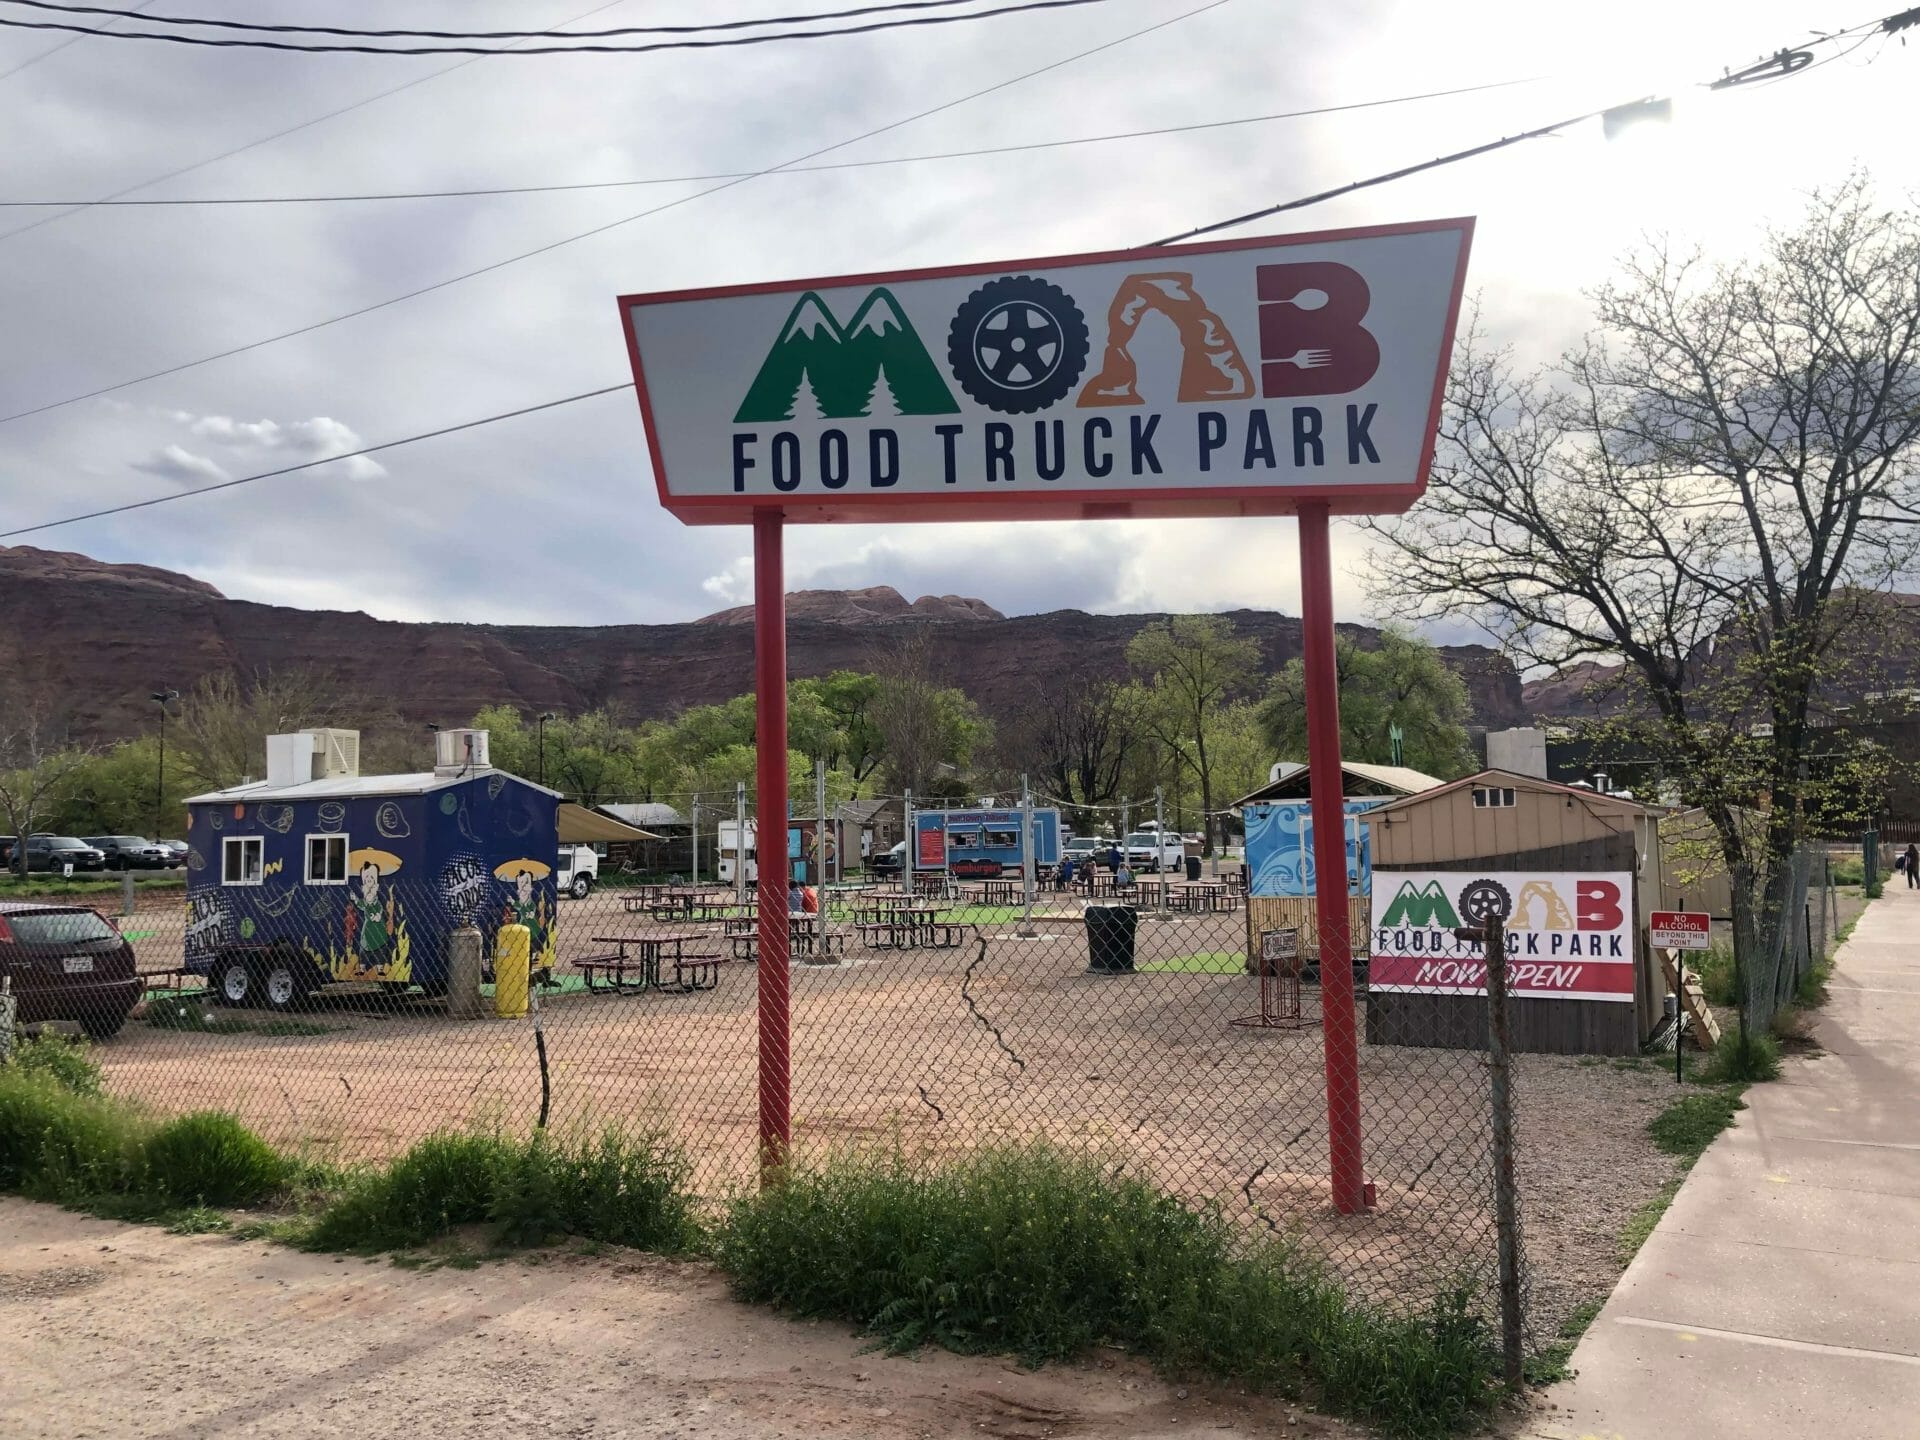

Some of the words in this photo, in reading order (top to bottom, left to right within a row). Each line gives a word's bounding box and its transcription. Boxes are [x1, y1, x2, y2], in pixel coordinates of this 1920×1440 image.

[733, 427, 900, 492] FOOD
[935, 413, 1165, 484] TRUCK
[1198, 403, 1381, 472] PARK
[1655, 931, 1686, 939] BEYOND
[1688, 932, 1705, 940] THIS
[1659, 921, 1702, 930] ALCOHOL
[1379, 930, 1442, 951] FOOD
[1455, 931, 1540, 955] TRCK
[1551, 933, 1623, 957] PARK
[1415, 961, 1487, 985] NOW
